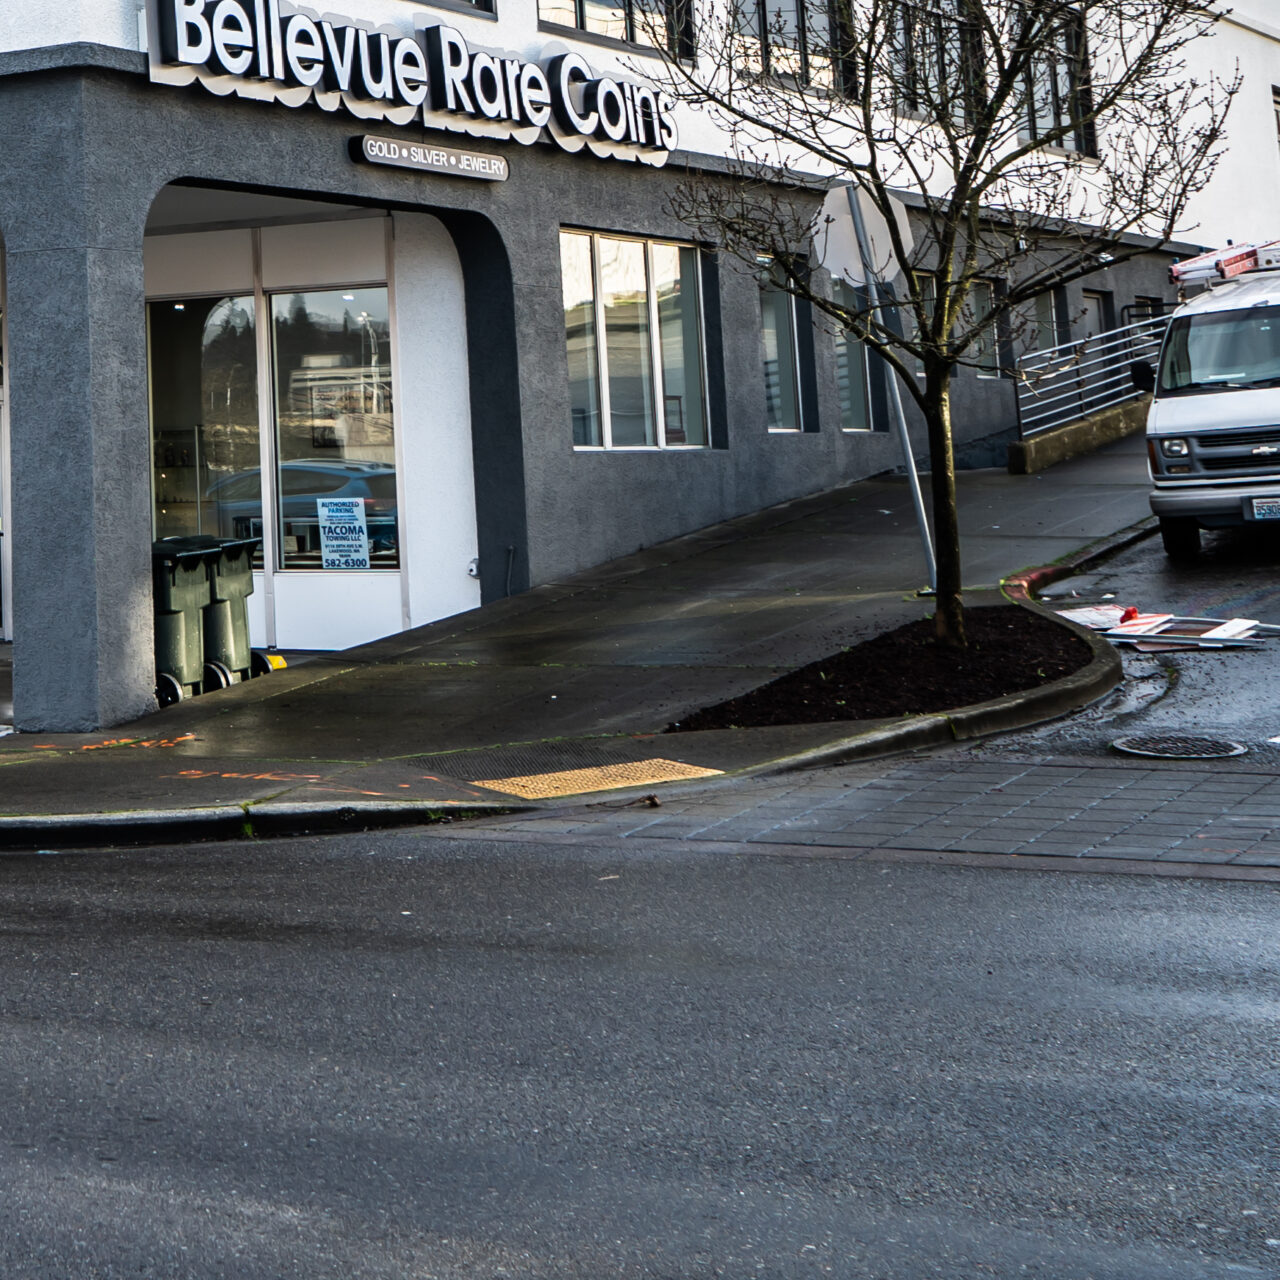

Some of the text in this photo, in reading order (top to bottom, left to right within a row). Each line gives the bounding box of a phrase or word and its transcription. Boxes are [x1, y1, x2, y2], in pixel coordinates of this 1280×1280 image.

[434, 25, 551, 128] Rare
[558, 52, 678, 152] Coins
[367, 140, 505, 176] GOLD SILVER JEWELRY
[321, 526, 364, 535] TACOMA
[325, 558, 367, 567] 582-6300
